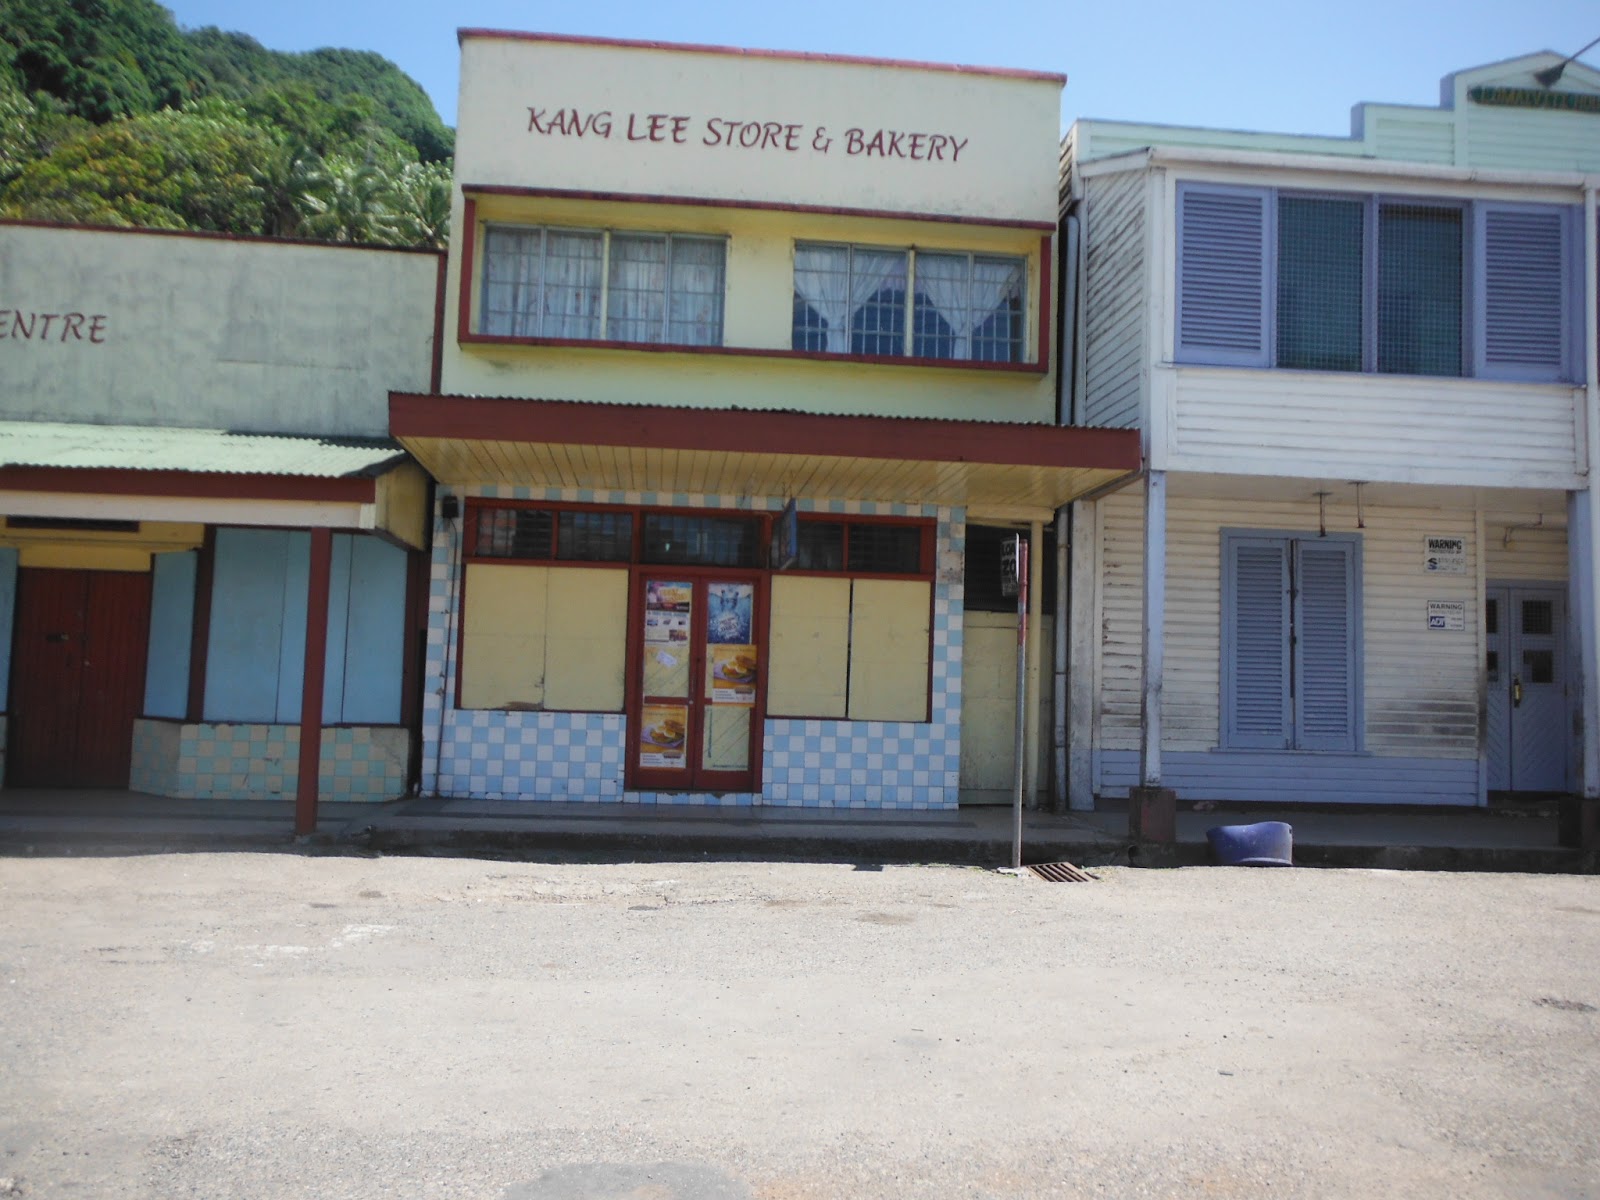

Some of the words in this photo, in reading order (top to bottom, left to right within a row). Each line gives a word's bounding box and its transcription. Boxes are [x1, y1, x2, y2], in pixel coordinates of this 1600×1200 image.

[526, 106, 612, 139] KANG
[627, 113, 691, 144] LEE
[702, 117, 803, 151] STORE
[812, 126, 833, 154] &
[844, 128, 969, 162] BAKERY
[1428, 539, 1462, 549] WARNING
[1430, 616, 1444, 626] ADT
